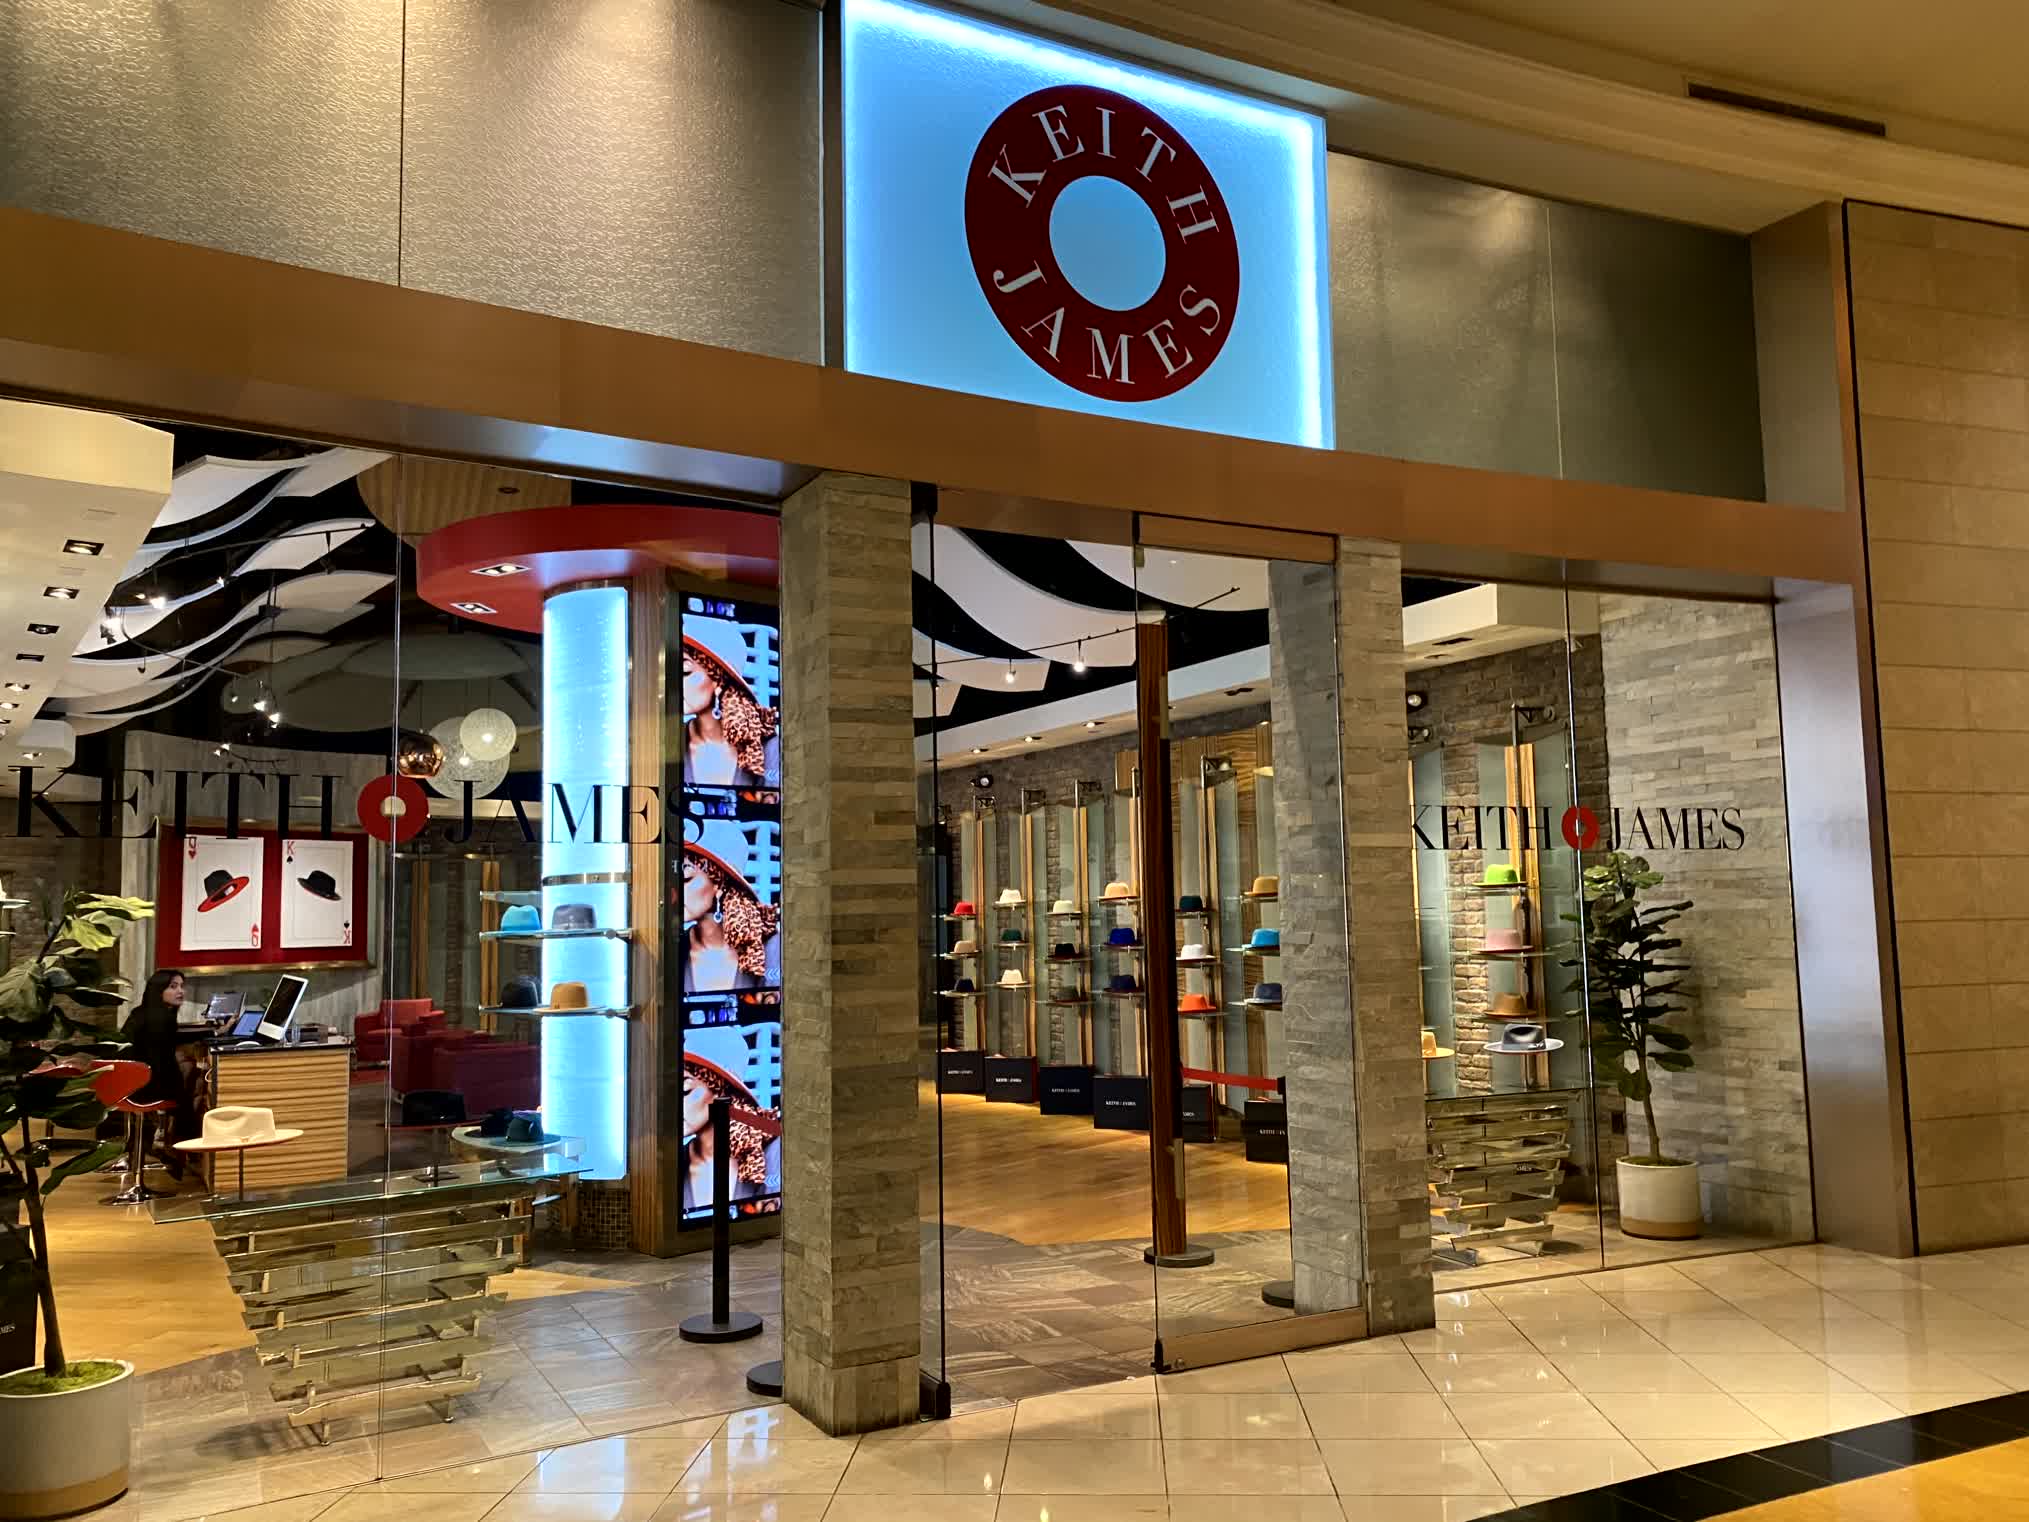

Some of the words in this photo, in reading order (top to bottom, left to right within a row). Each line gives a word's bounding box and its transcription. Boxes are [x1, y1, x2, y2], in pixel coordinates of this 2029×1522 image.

[987, 105, 1220, 245] KEITH
[992, 260, 1221, 385] JAMES
[6, 765, 345, 841] KEITH
[444, 779, 705, 846] JAMES
[1409, 803, 1554, 851] KEITH
[1606, 806, 1746, 851] JAMES
[286, 840, 295, 856] K
